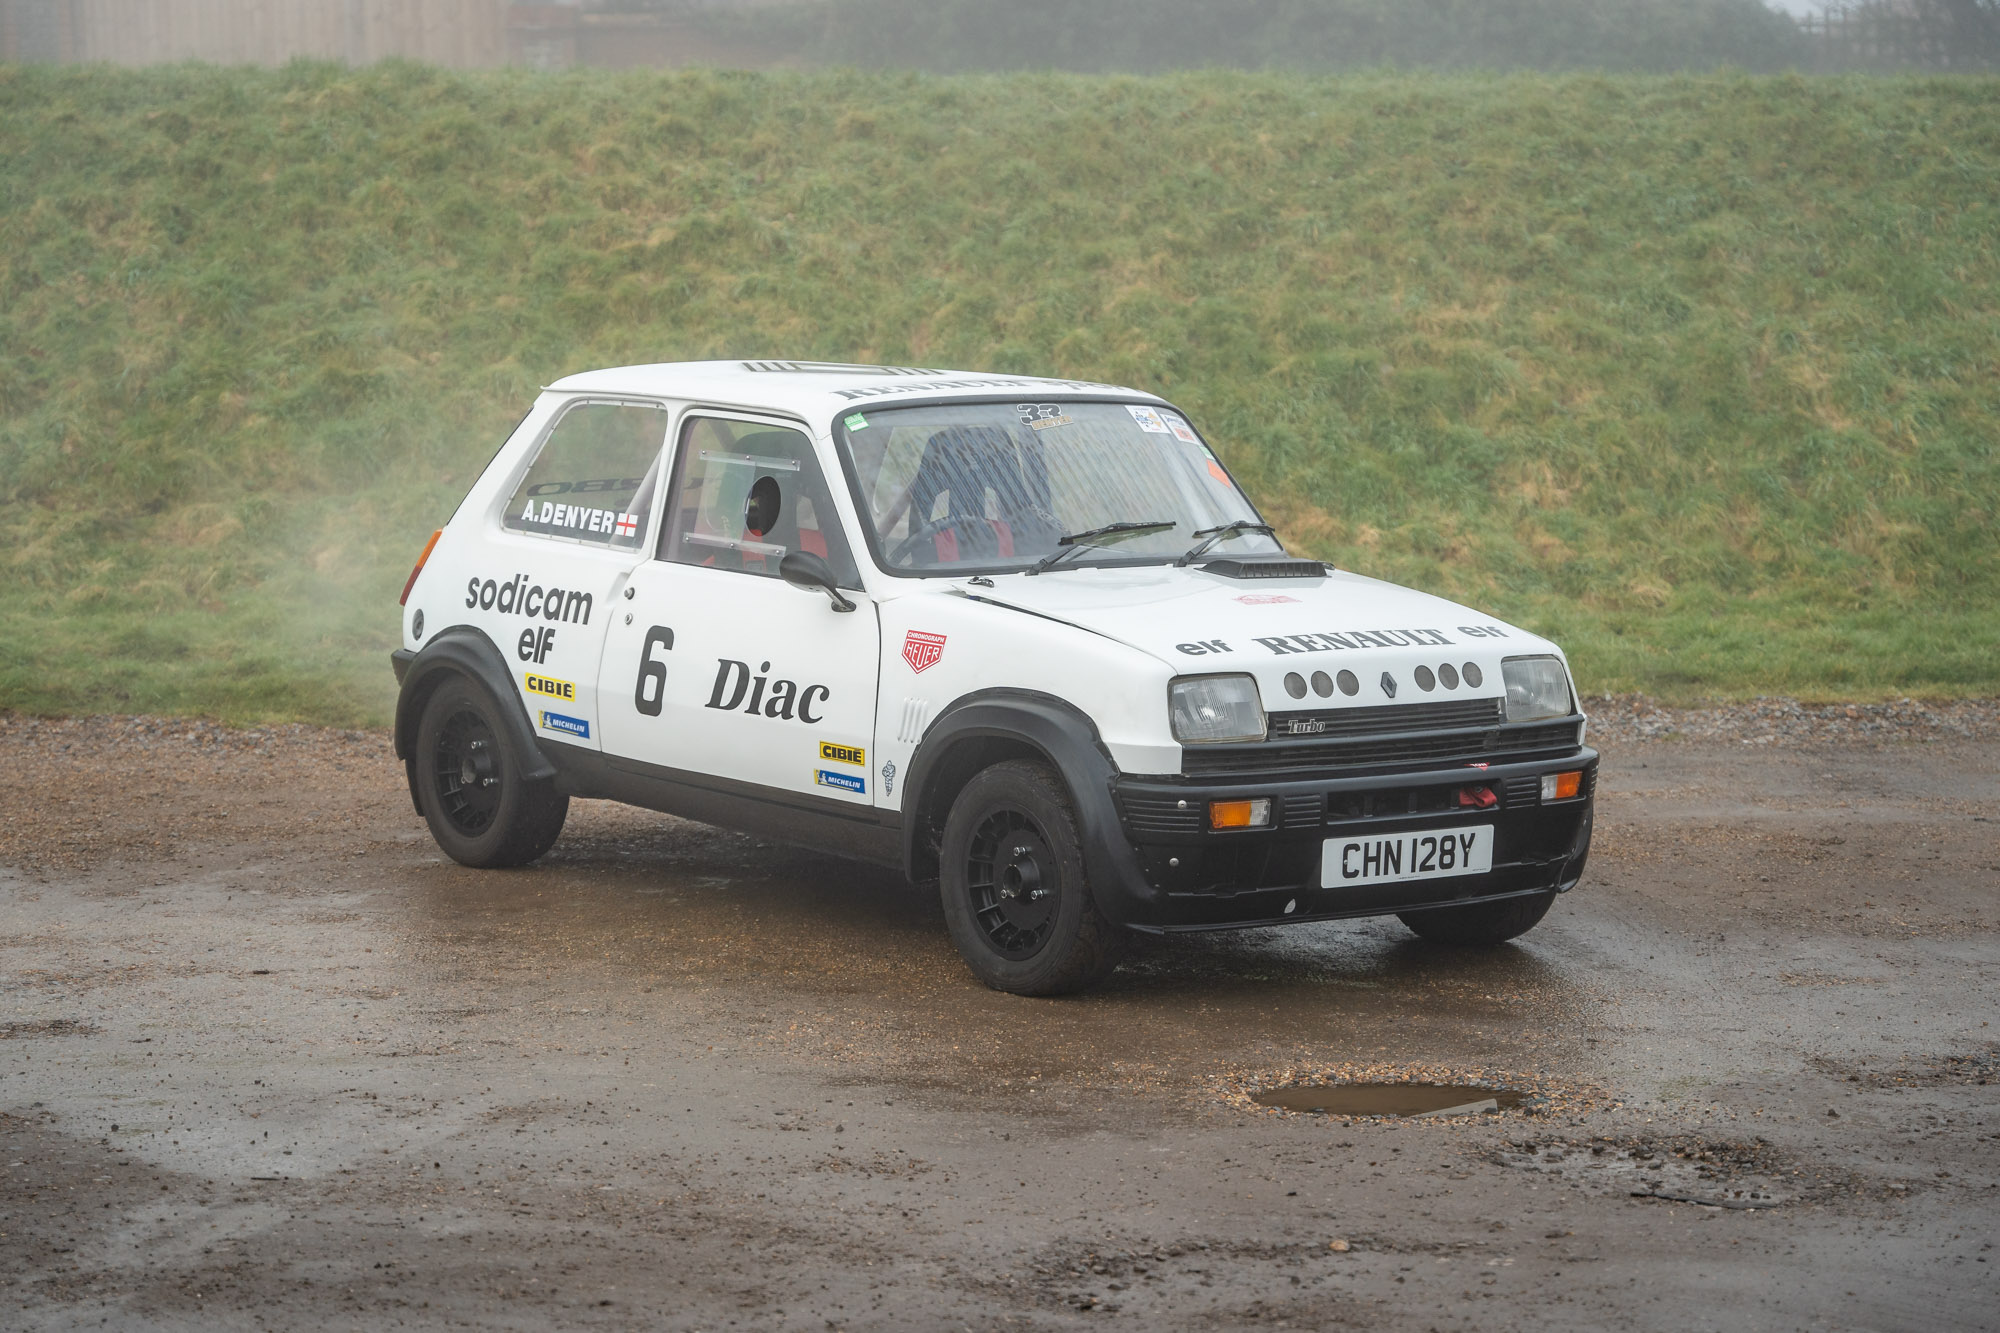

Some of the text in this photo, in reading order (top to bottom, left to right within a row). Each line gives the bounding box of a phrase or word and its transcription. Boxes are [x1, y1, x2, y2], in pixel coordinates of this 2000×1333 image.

[831, 380, 1031, 400] RENAULT
[521, 499, 615, 534] A.DENYER
[465, 573, 593, 626] sodicam
[517, 626, 556, 664] elf
[907, 631, 945, 644] CHRONOGRAPH
[1175, 626, 1510, 656] elf RENAULT elf
[905, 642, 940, 669] HEUER
[634, 625, 675, 717] 6
[704, 658, 830, 724] Diac
[552, 718, 585, 733] MICHELIN
[1288, 719, 1326, 733] Turbo
[827, 775, 861, 789] MICHELIN
[1342, 832, 1476, 879] CHN 128Y
